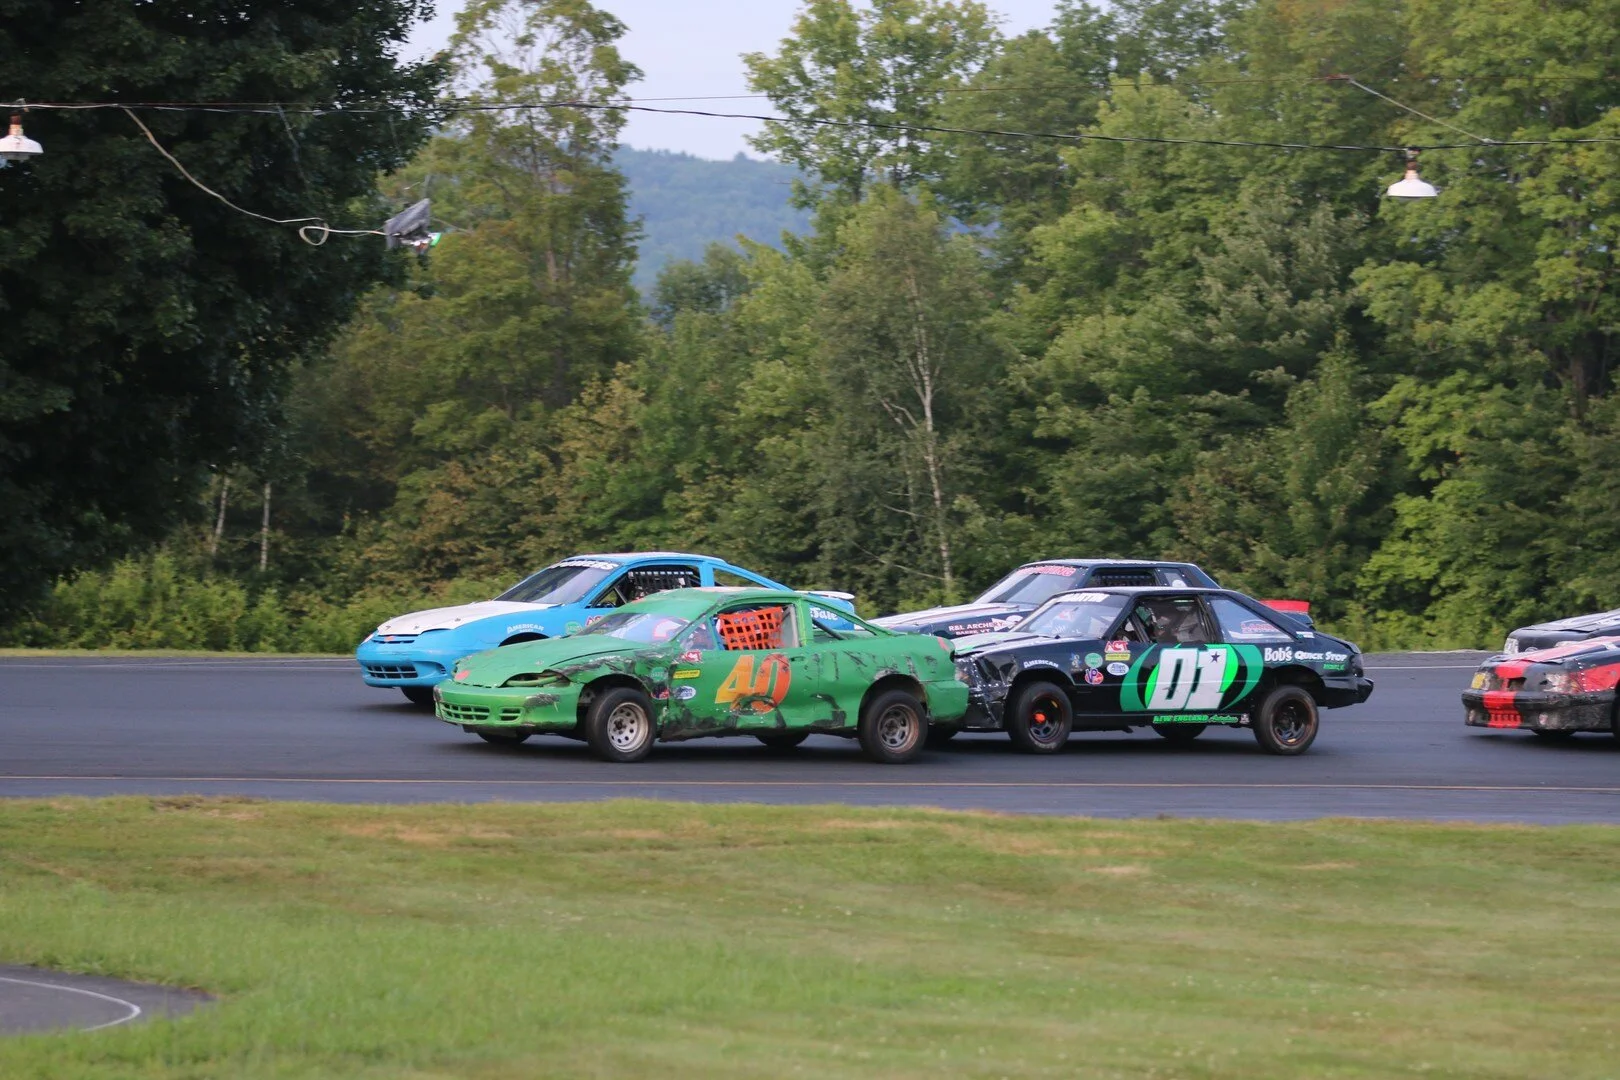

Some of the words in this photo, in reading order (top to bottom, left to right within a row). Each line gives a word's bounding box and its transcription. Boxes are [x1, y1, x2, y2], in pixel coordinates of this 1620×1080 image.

[507, 623, 545, 634] AMERICAN
[1104, 640, 1130, 653] ACT
[1264, 646, 1293, 662] Bob's
[1023, 659, 1059, 669] AMERICAN
[715, 652, 792, 714] 40
[1147, 648, 1227, 710] 01
